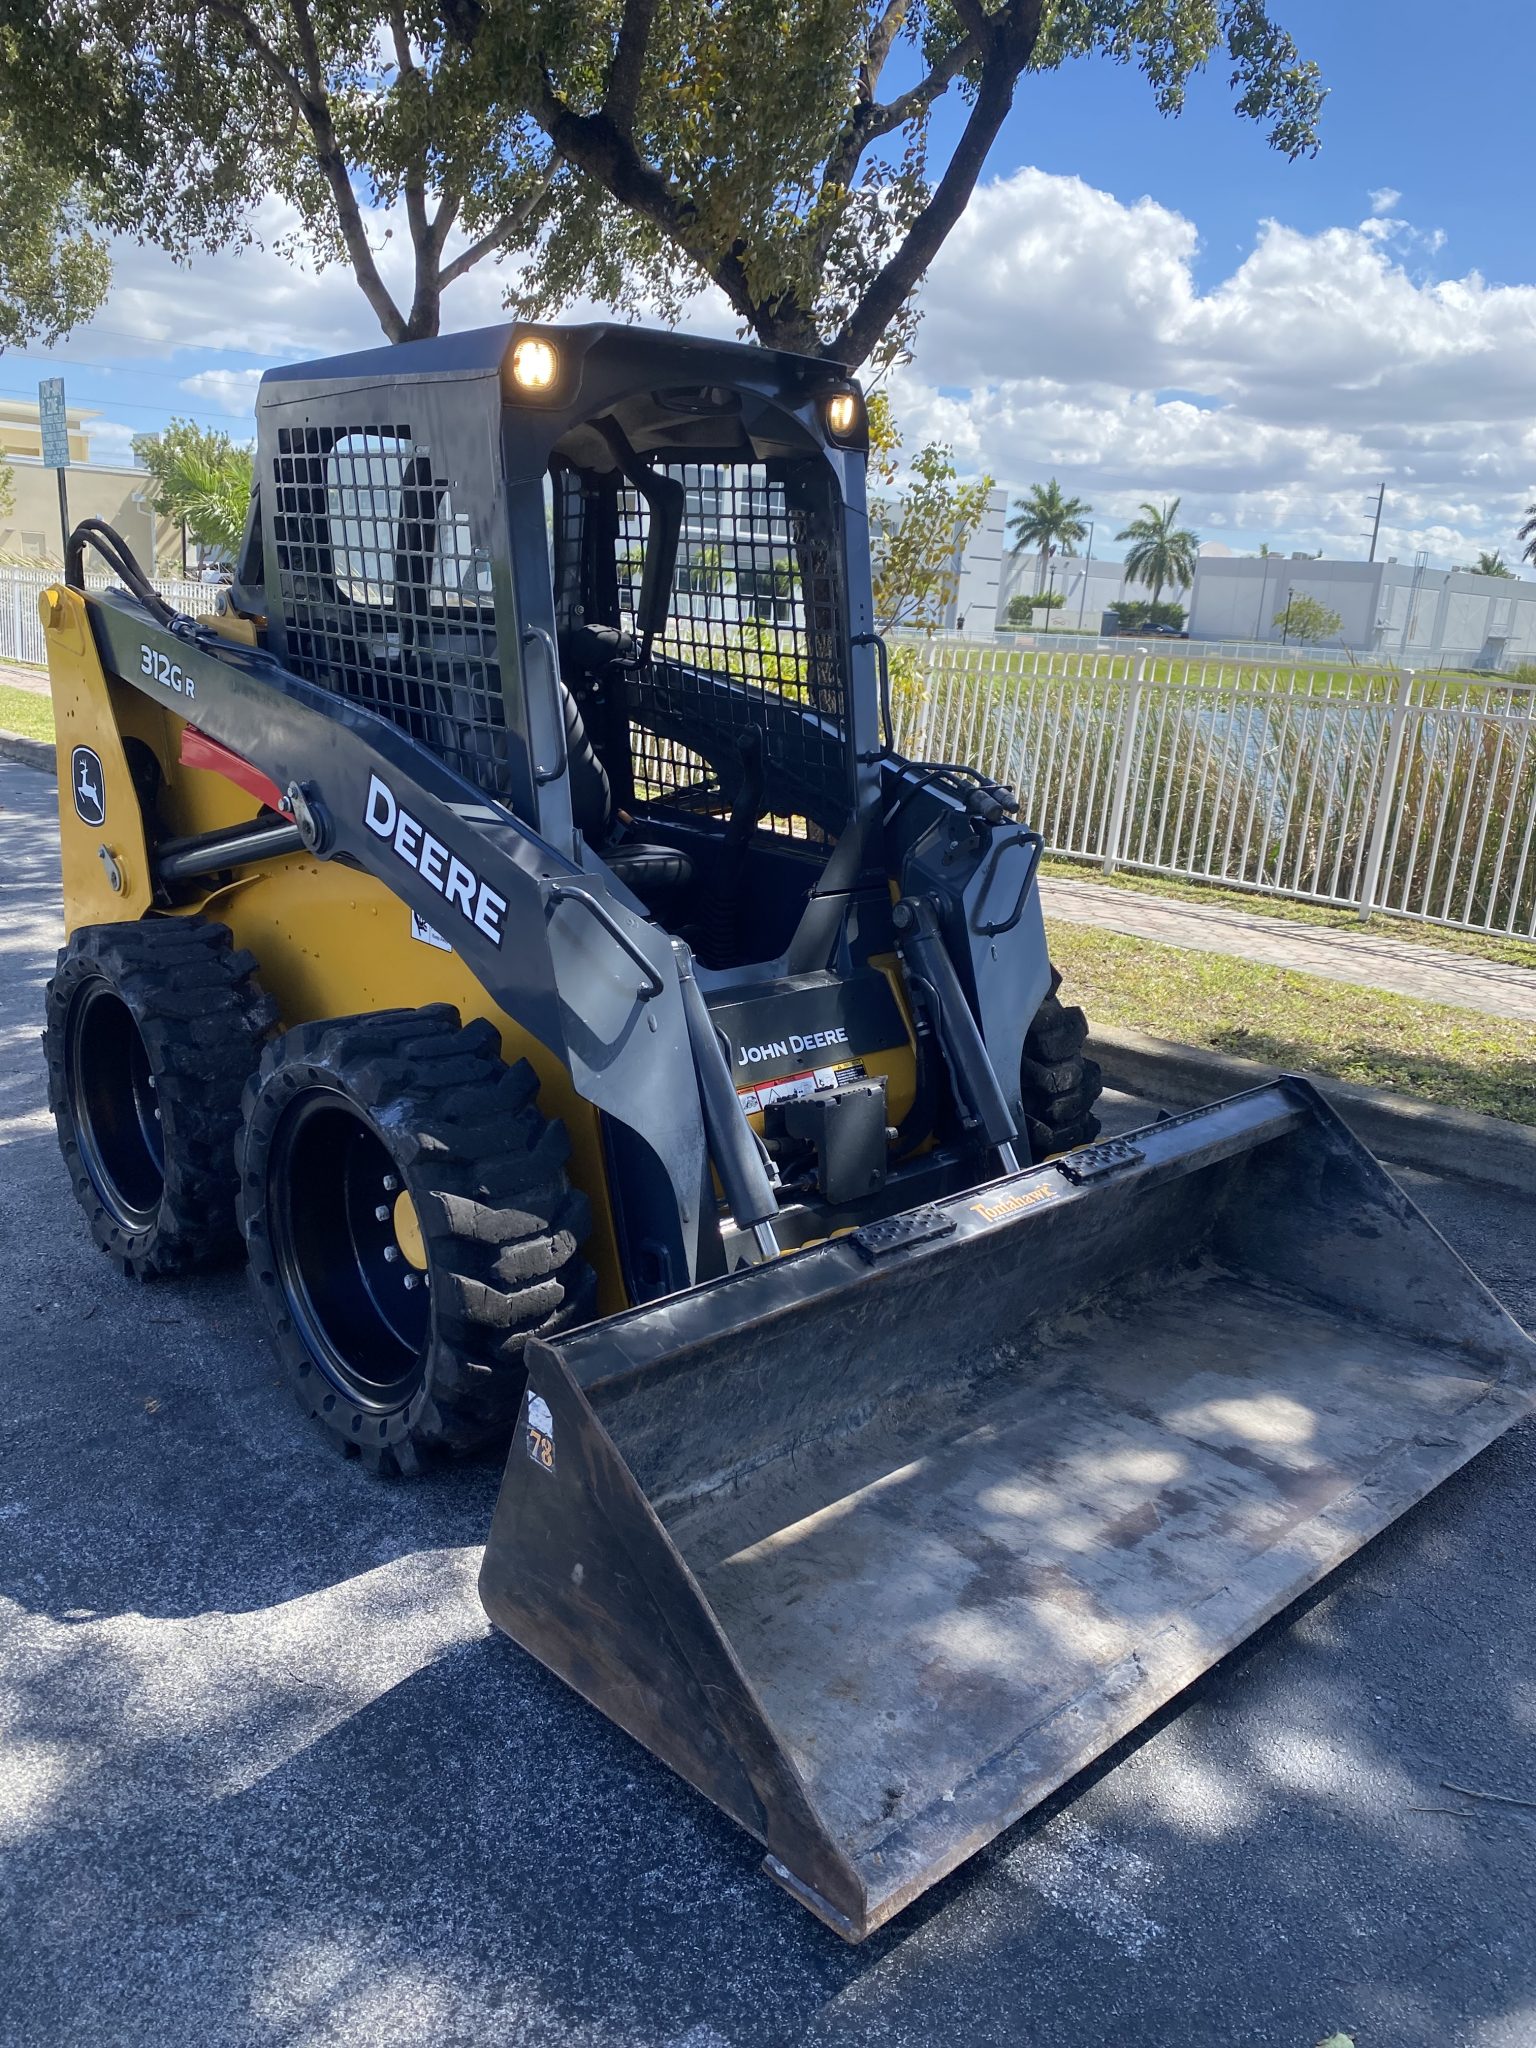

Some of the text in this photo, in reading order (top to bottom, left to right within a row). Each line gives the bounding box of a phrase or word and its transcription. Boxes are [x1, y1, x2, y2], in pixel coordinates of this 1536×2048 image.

[141, 644, 195, 699] 312G R
[365, 774, 507, 945] DEERE
[738, 1027, 849, 1066] JOHN DEERE
[970, 1183, 1058, 1223] Tomahawk
[529, 1429, 553, 1467] 78
